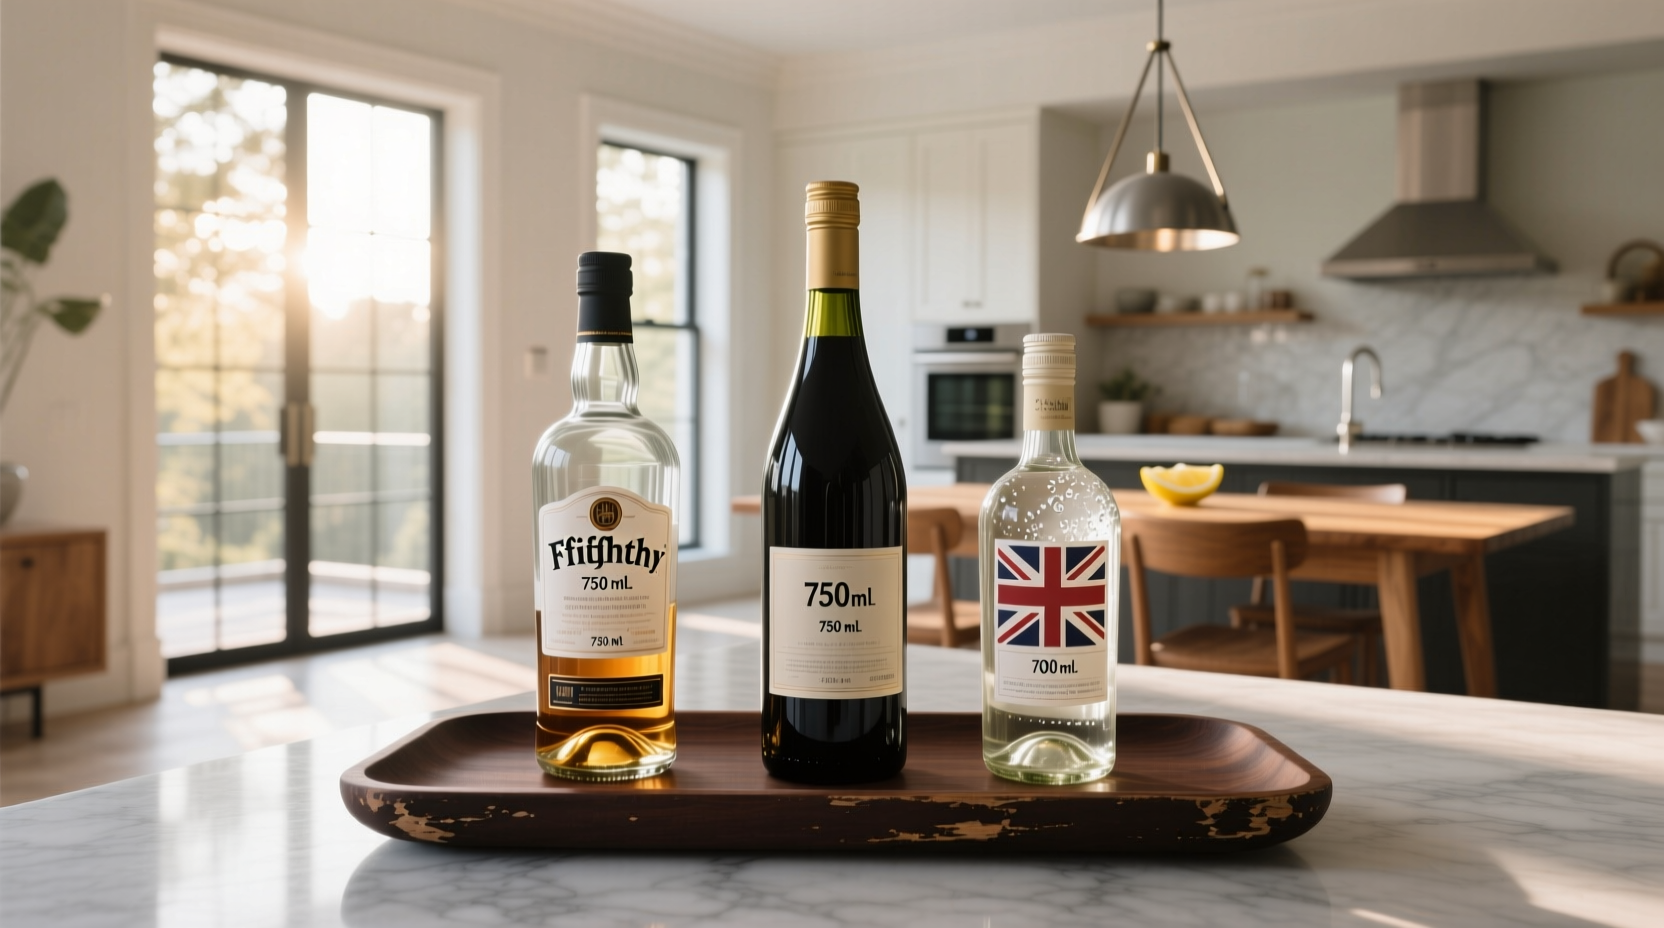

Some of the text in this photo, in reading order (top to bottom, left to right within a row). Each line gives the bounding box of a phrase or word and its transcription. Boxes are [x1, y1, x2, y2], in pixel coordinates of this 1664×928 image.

[581, 576, 608, 591] 750
[819, 619, 862, 633] 750 mL
[1031, 659, 1058, 674] 700
